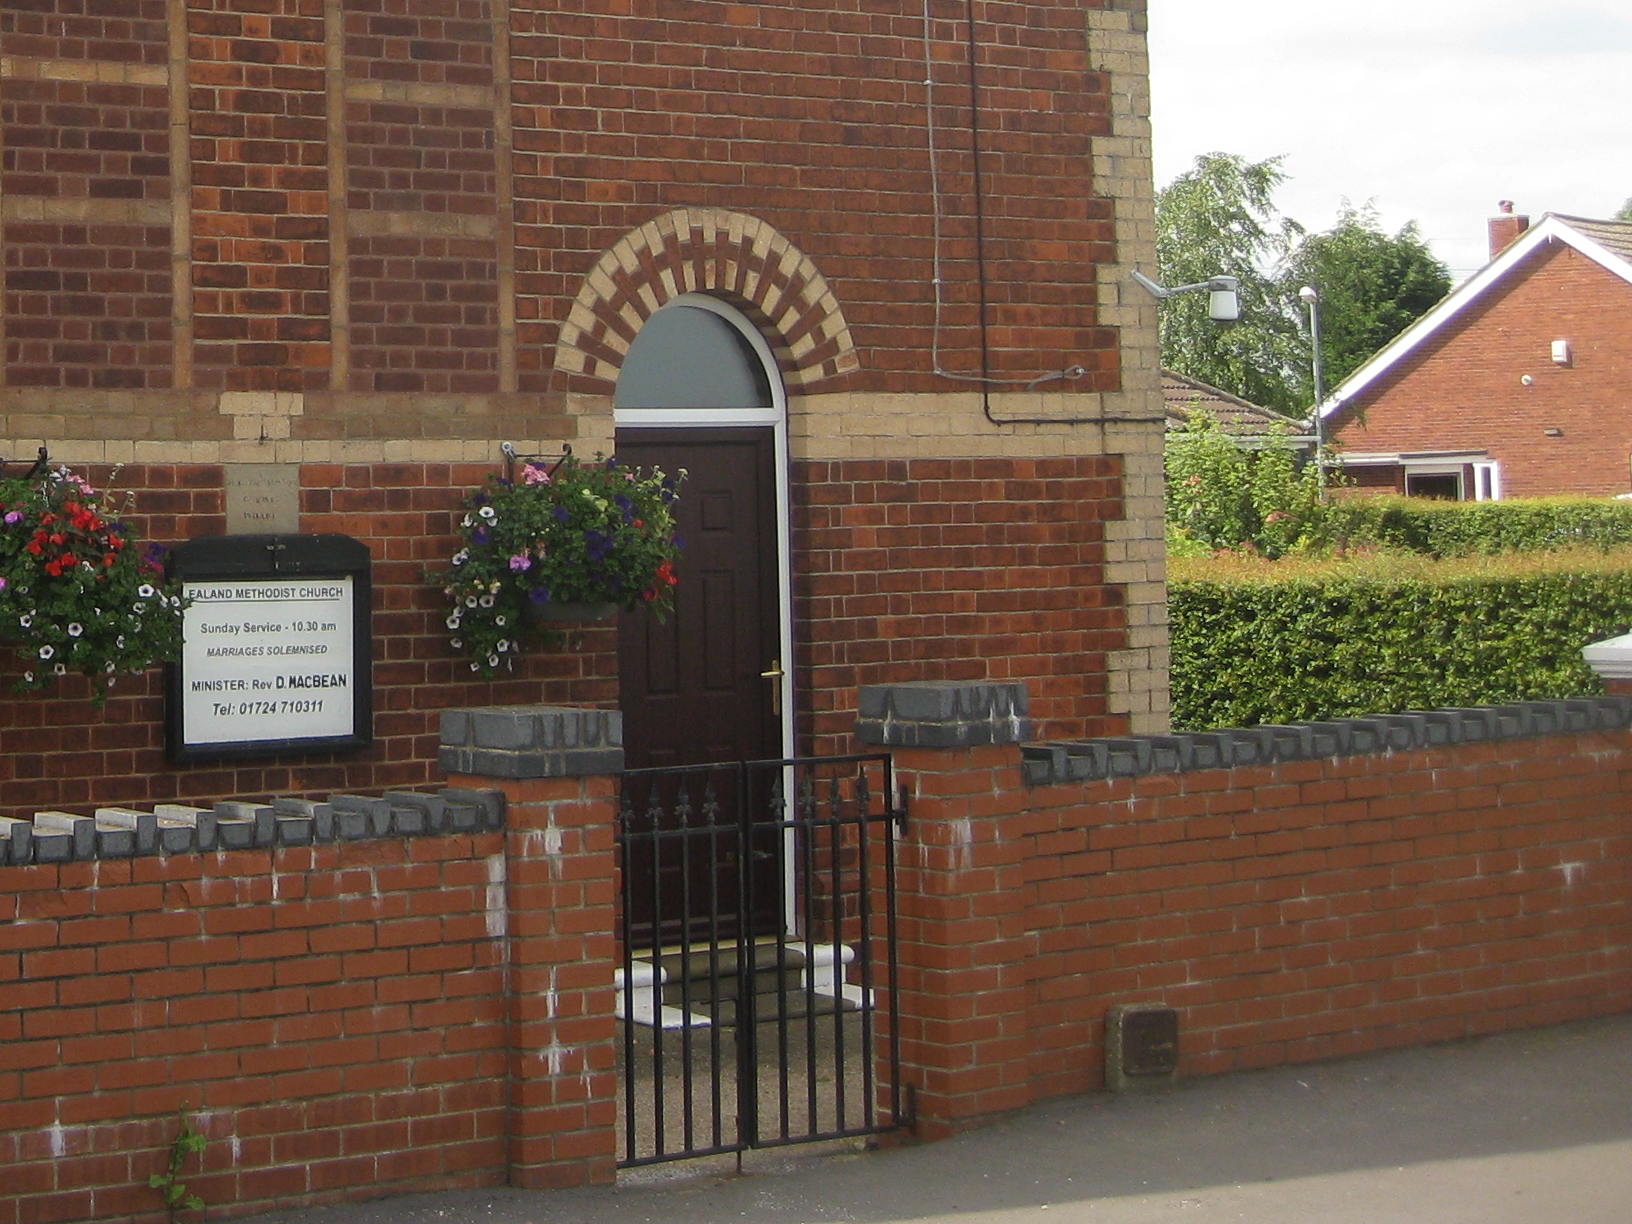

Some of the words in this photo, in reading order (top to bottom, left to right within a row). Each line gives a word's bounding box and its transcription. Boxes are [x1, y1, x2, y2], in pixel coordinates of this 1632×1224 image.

[188, 589, 232, 599] EALAND
[236, 588, 296, 598] METHODIST
[299, 587, 343, 598] CHURCH
[201, 623, 240, 635] Sunday
[243, 622, 282, 633] Service
[292, 621, 318, 631] 10.30
[321, 623, 336, 631] am
[207, 646, 264, 657] MARRIAGES
[267, 645, 328, 655] SOLEMNISED
[192, 680, 249, 691] MINISTER:
[252, 680, 272, 690] Rev
[213, 703, 235, 715] Tel:
[239, 702, 276, 715] 01724
[282, 700, 323, 713] 710311
